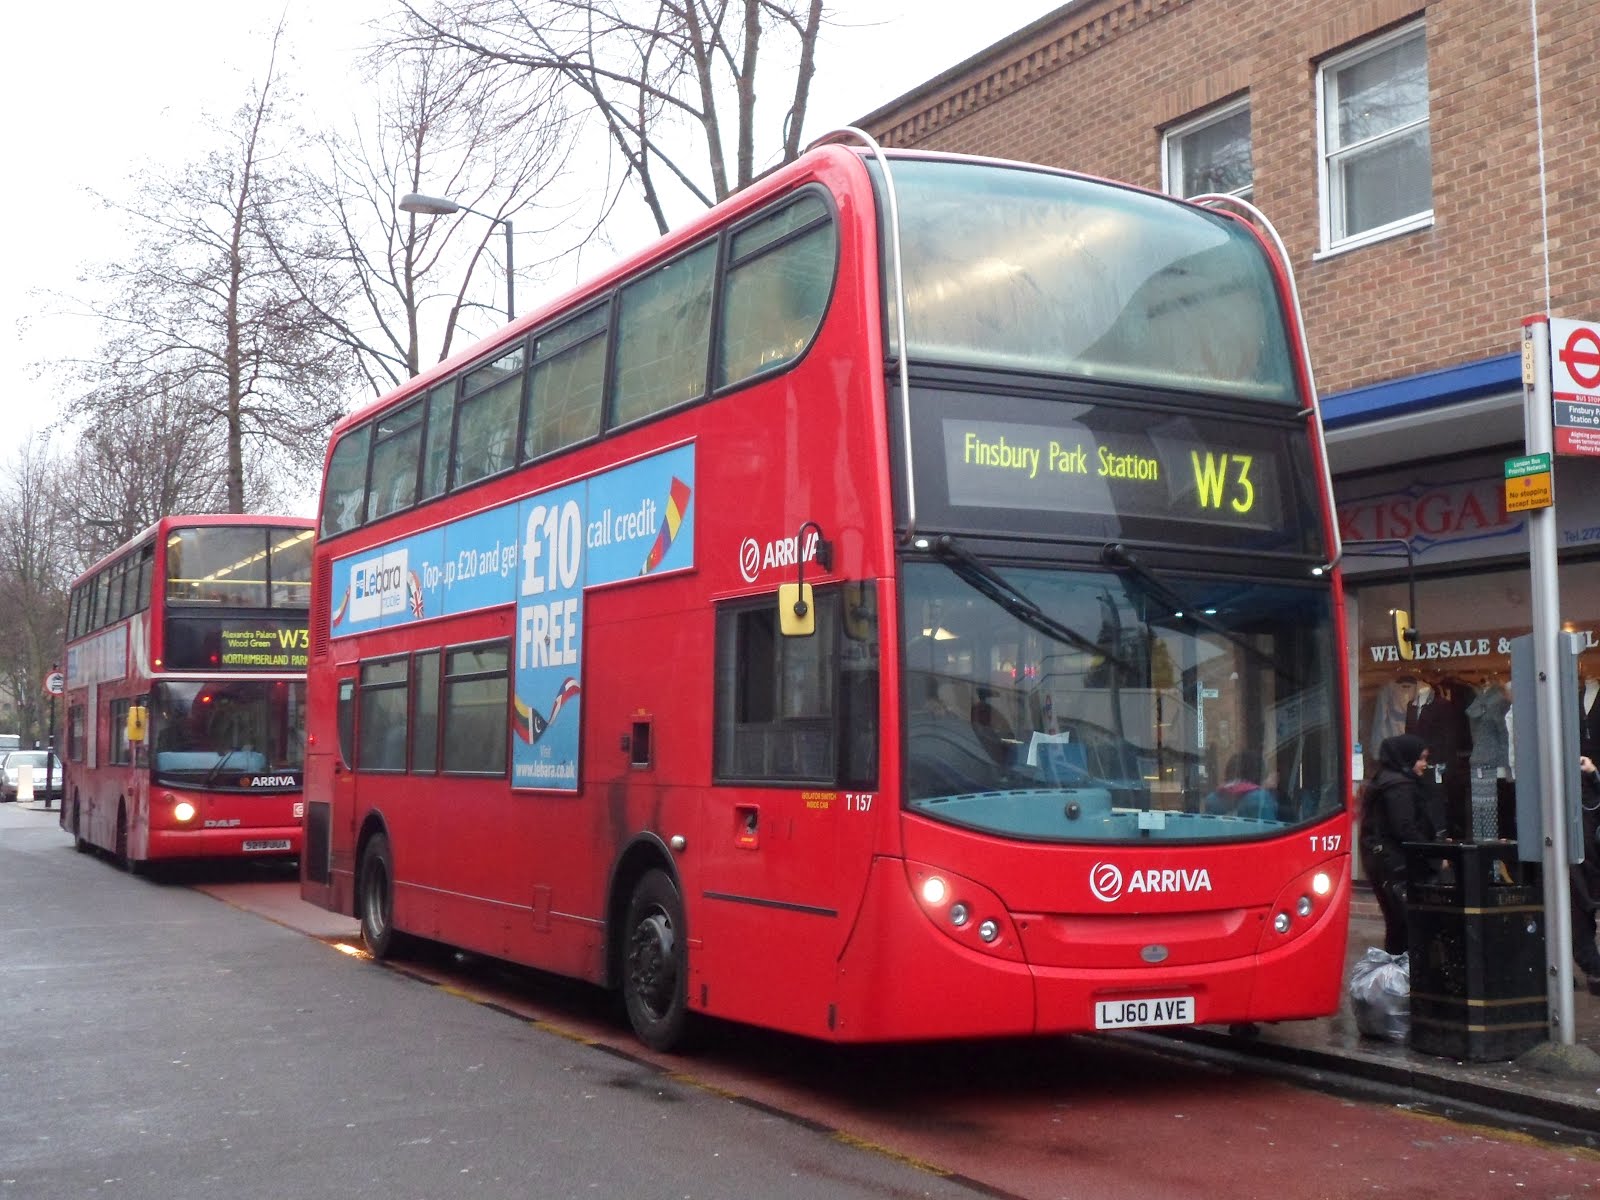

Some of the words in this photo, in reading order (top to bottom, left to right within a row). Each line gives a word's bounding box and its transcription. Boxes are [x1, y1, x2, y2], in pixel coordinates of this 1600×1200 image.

[1576, 394, 1587, 402] BUS
[1569, 405, 1594, 417] Finsbury
[1570, 415, 1592, 424] Station
[965, 433, 1040, 479] Finsbury
[1049, 441, 1087, 474] Park
[1098, 446, 1158, 481] Station
[1191, 450, 1254, 513] W3
[1520, 488, 1548, 497] stopping
[1508, 500, 1529, 508] except
[587, 510, 612, 549] call
[614, 499, 657, 543] credit
[521, 500, 581, 597] £10
[457, 550, 478, 580] £20
[479, 540, 500, 575] and
[364, 565, 401, 597] Lebara
[222, 630, 254, 639] Alexandra
[255, 631, 277, 639] Palace
[277, 629, 309, 648] W3
[520, 598, 578, 669] FREE
[228, 639, 249, 648] Wood
[249, 639, 271, 647] Green
[1371, 638, 1491, 662] WHLESALE
[222, 653, 289, 665] NORTHUMBERLAND
[251, 776, 295, 787] ARRIVA
[845, 793, 853, 811] T
[855, 794, 873, 811] 157
[1309, 836, 1318, 852] T
[1322, 835, 1342, 851] 157
[1127, 869, 1212, 893] ARRIVA
[1101, 1003, 1148, 1025] LJ60
[1153, 1000, 1187, 1022] AVE
